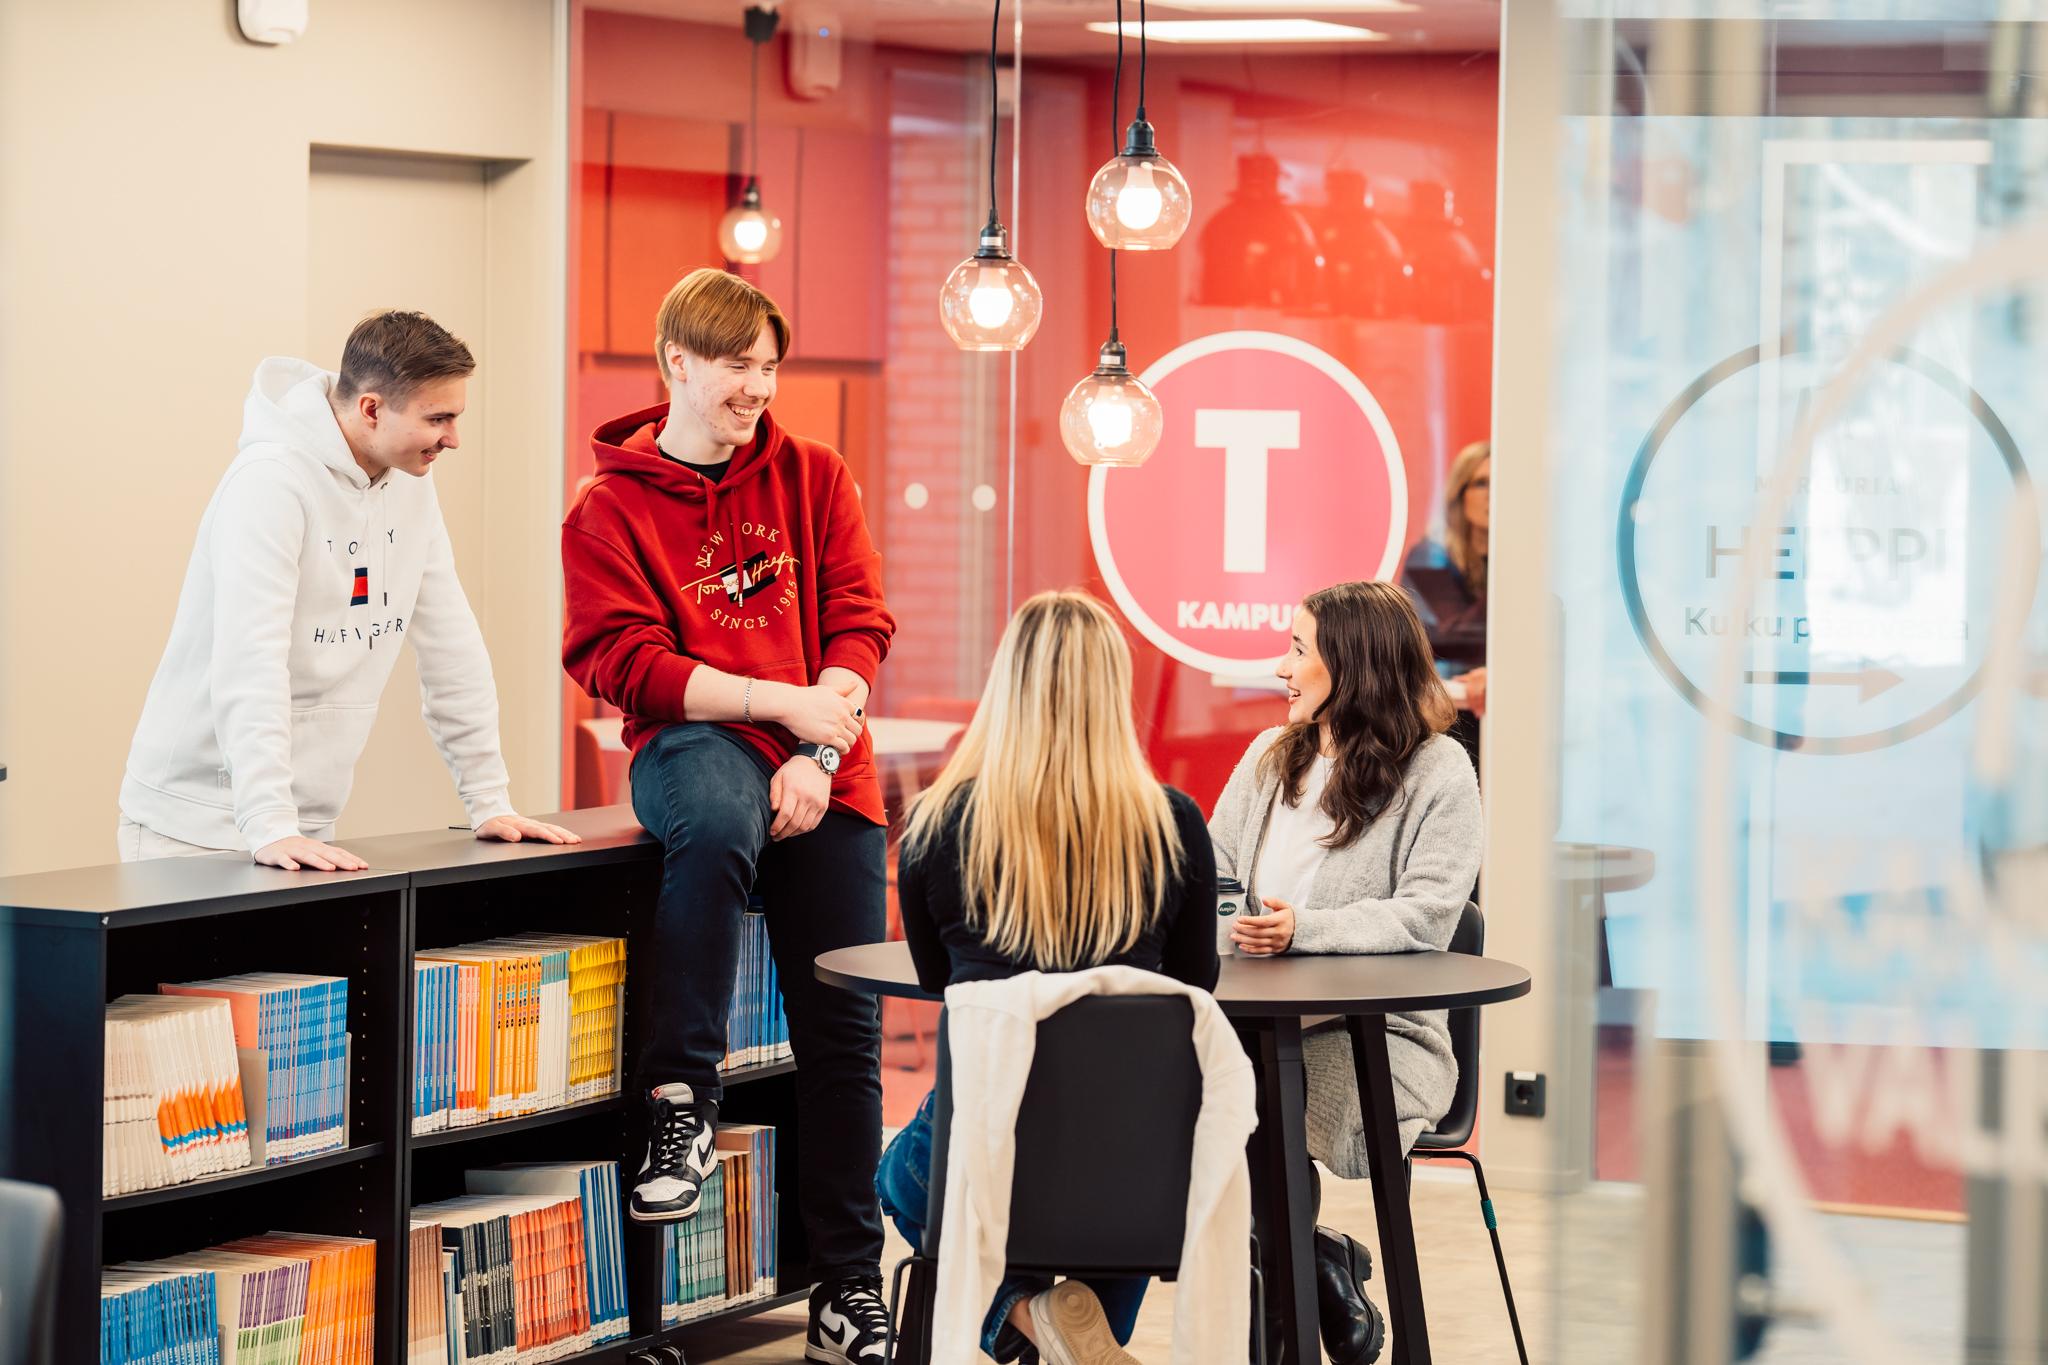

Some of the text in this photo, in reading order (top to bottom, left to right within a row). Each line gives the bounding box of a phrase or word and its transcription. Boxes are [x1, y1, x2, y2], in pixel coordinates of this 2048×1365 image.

[1195, 409, 1300, 573] T
[326, 528, 394, 555] TOY
[695, 522, 780, 569] NEW ORK
[1705, 525, 1946, 580] HEPPI
[710, 580, 798, 629] SINCE 1985
[1684, 606, 1782, 636] Kuku
